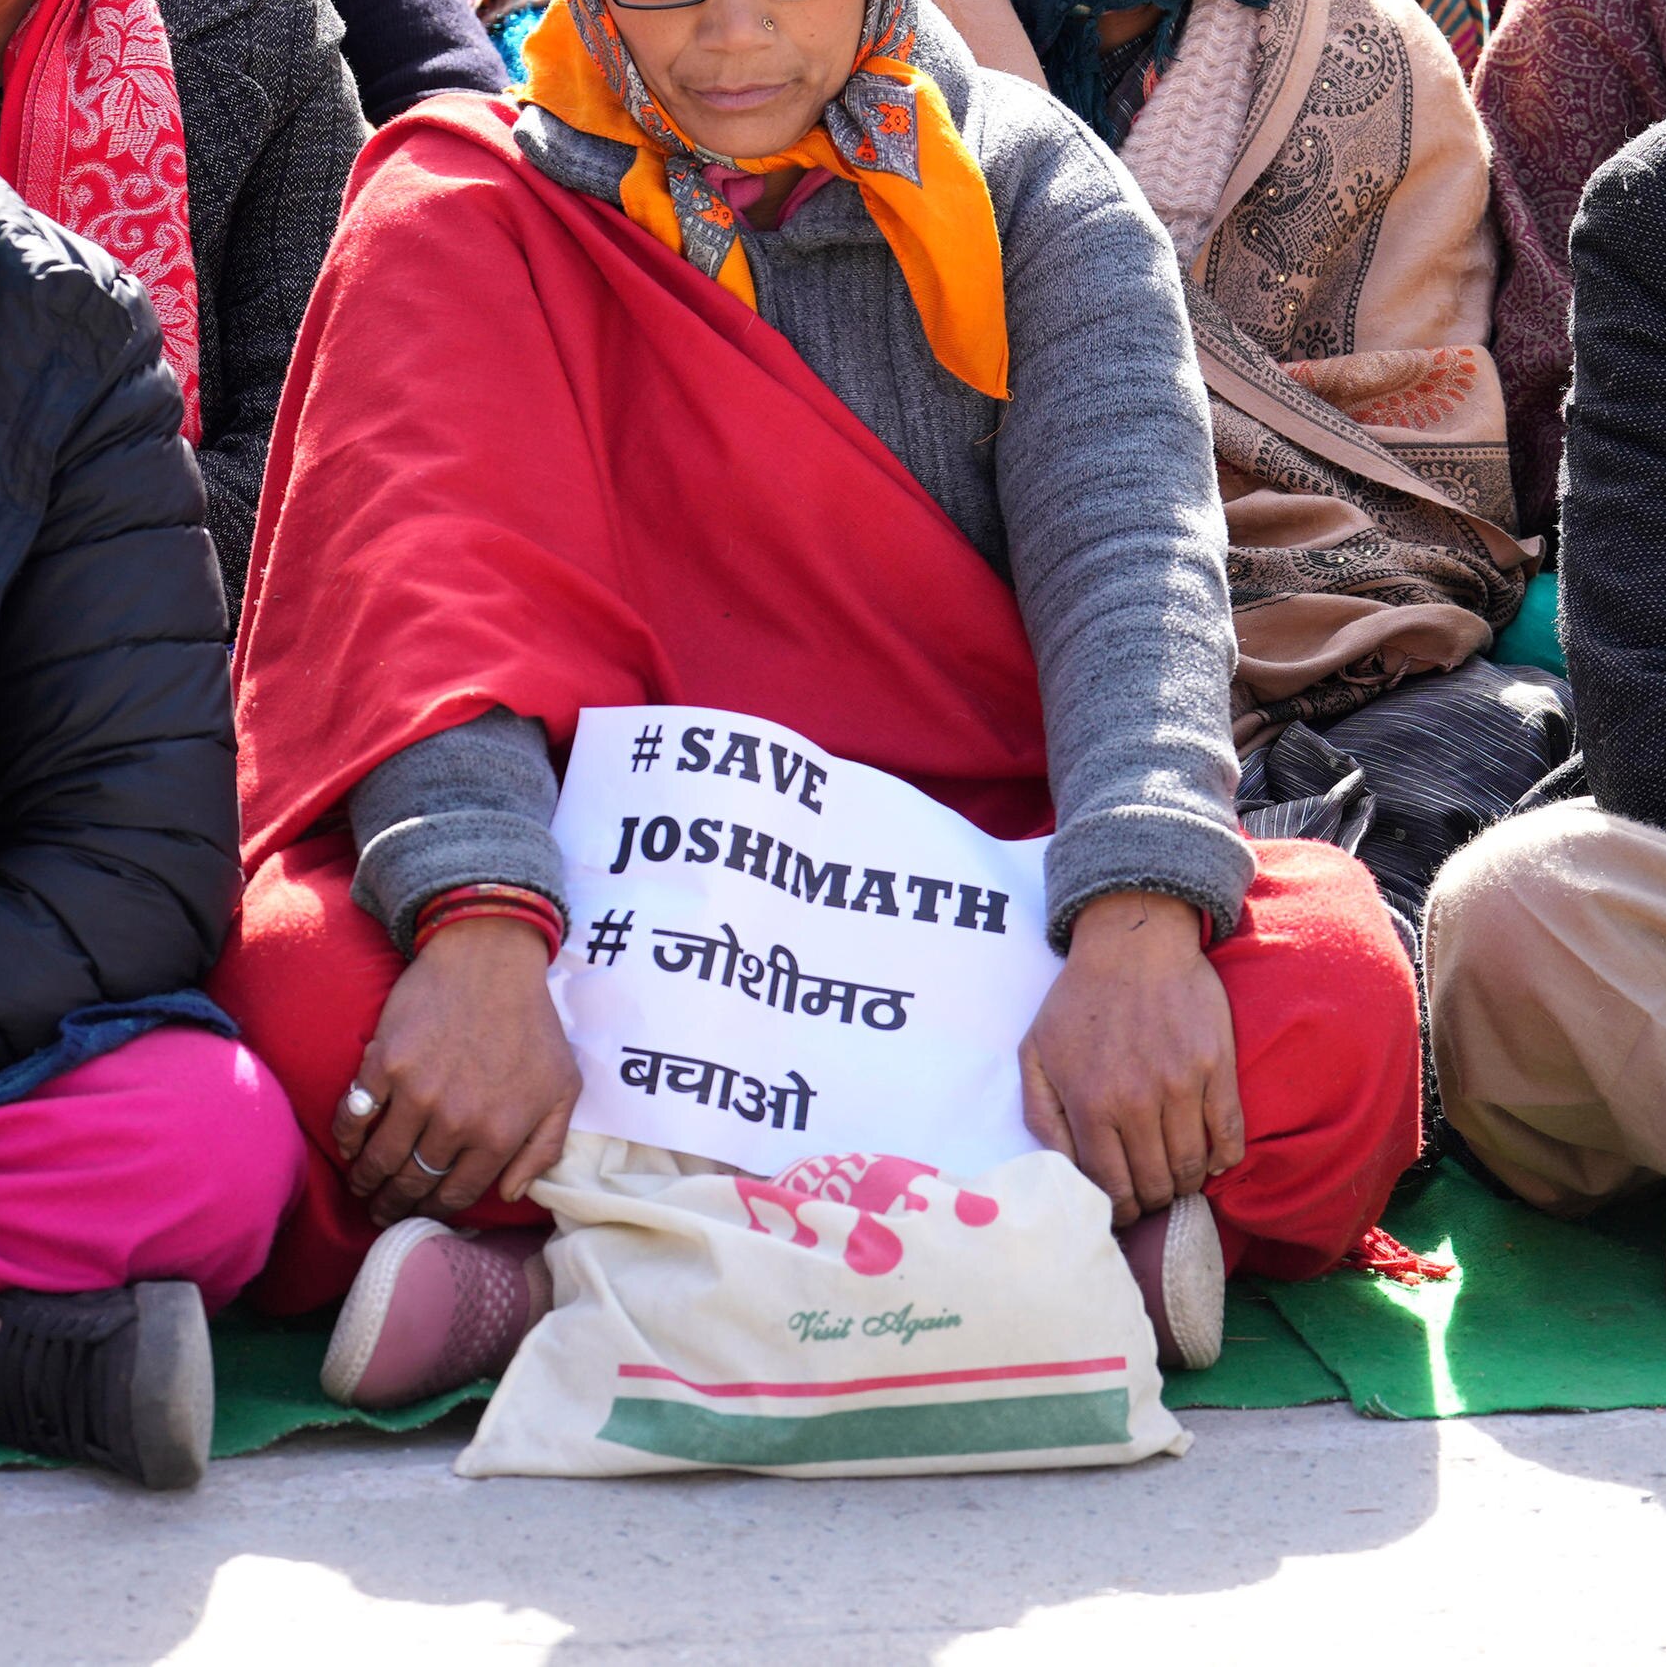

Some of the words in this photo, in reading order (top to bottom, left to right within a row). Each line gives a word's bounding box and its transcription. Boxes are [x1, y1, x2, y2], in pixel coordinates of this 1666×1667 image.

[676, 726, 828, 815] SAVE
[609, 815, 1010, 935] JOSHIMATH
[652, 923, 915, 1031] जोशीमठ
[620, 1046, 818, 1131] बचाओ
[788, 1309, 854, 1343] Visit
[862, 1302, 963, 1346] Again
